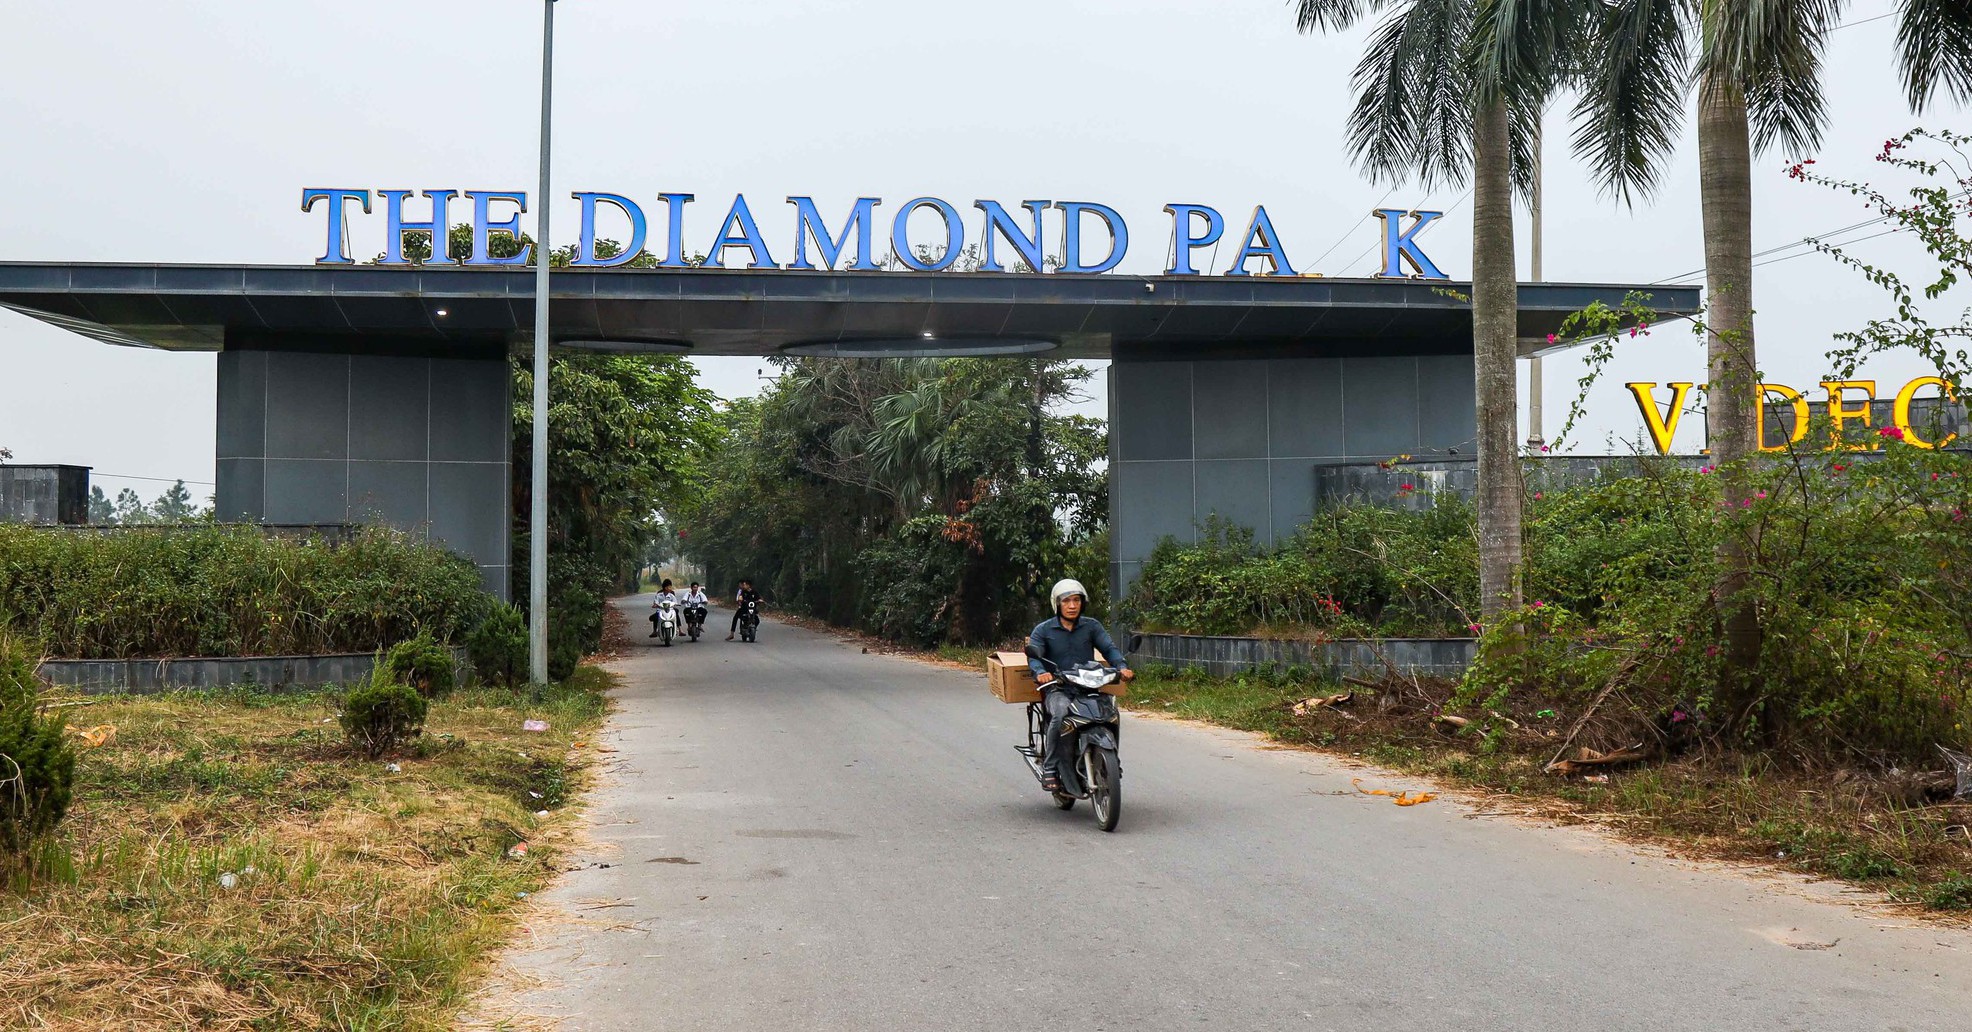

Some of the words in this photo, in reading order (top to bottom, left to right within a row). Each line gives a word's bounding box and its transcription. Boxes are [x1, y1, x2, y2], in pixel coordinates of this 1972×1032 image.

[302, 188, 534, 266] THE
[569, 191, 1128, 274] DIAMOND
[1625, 376, 1958, 454] VDEC
